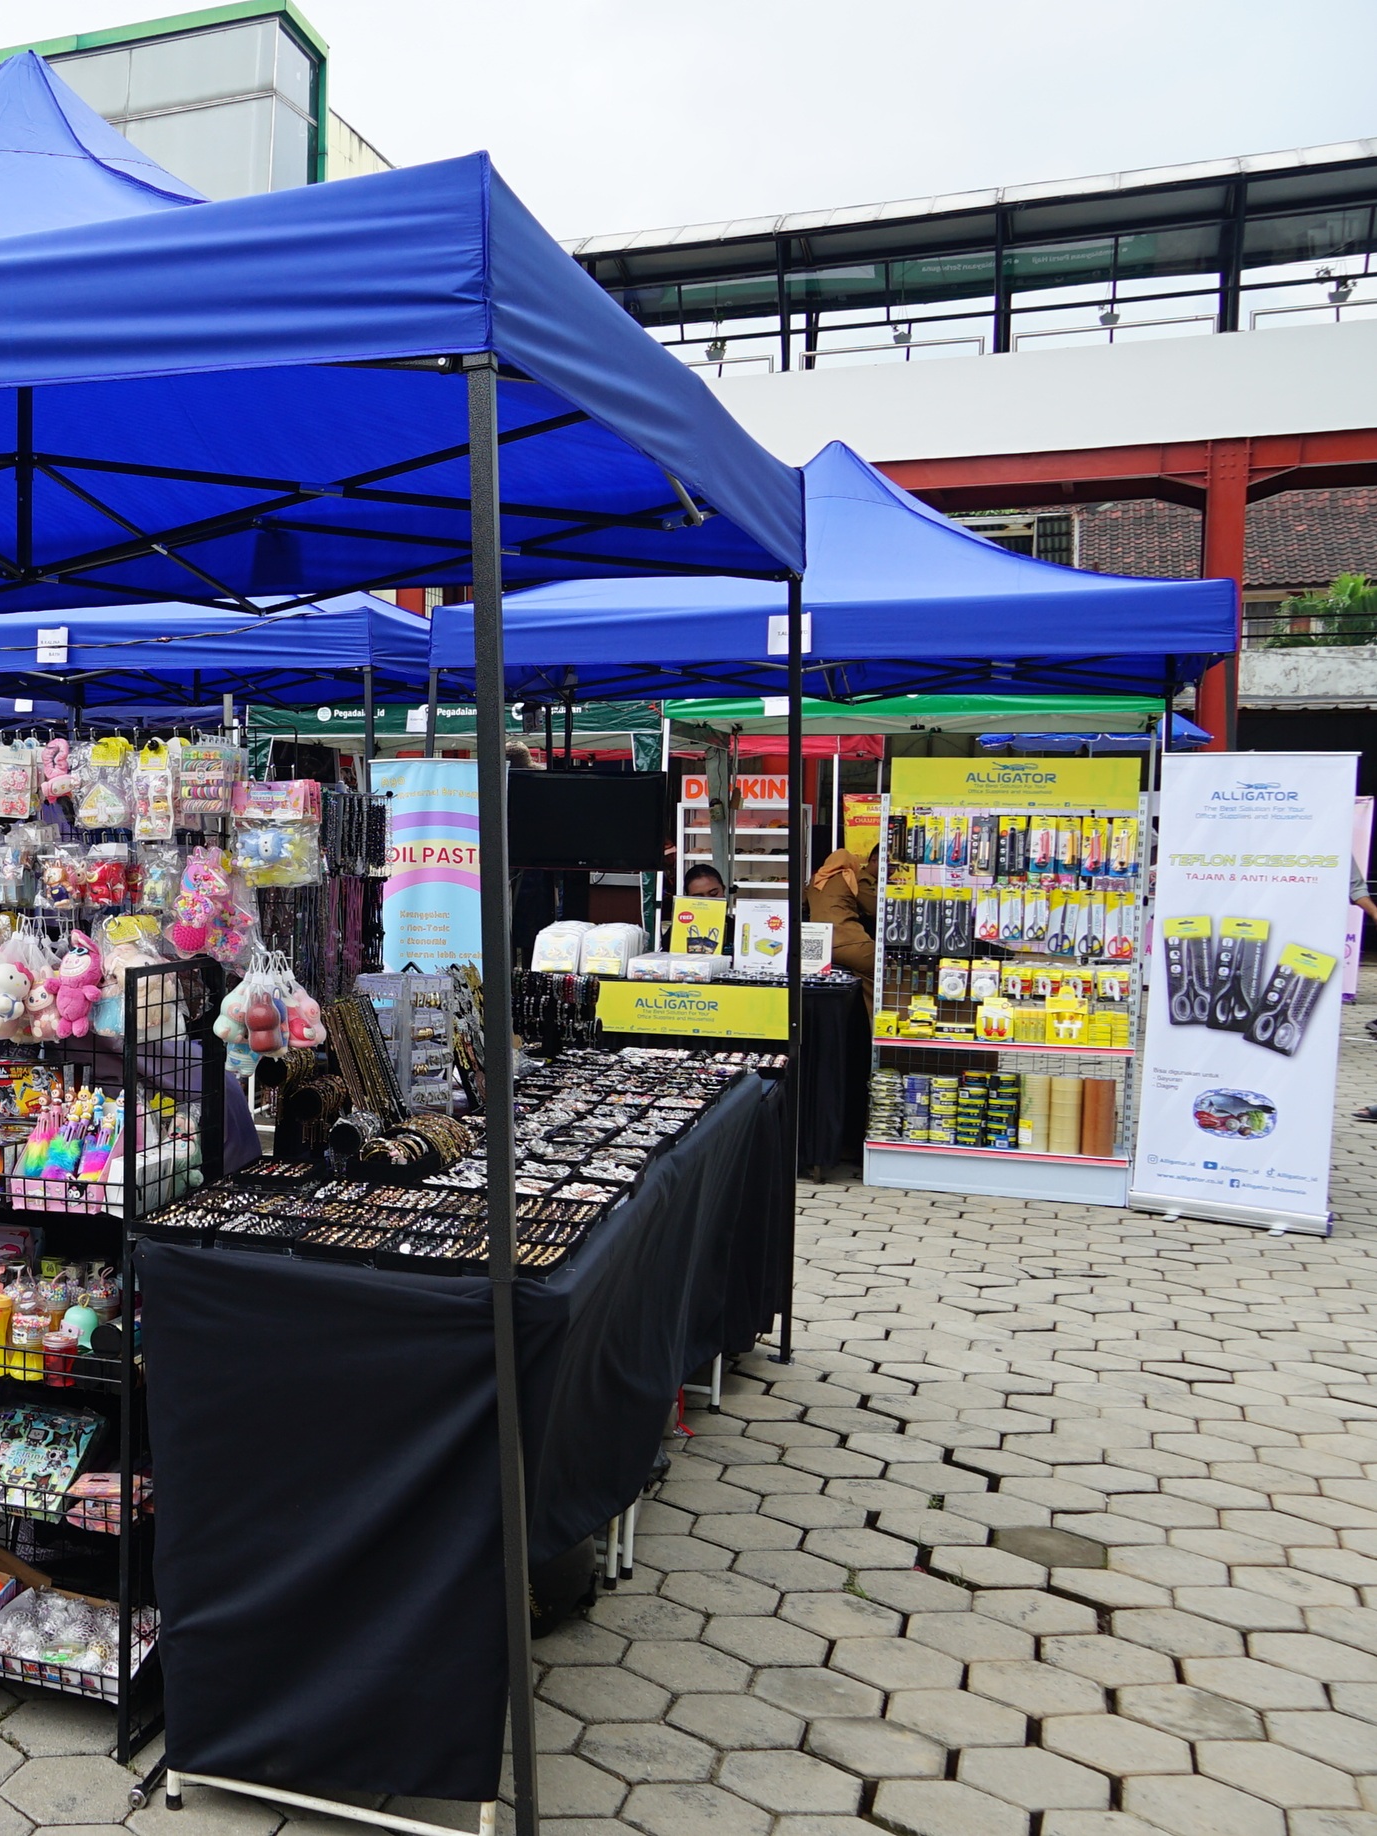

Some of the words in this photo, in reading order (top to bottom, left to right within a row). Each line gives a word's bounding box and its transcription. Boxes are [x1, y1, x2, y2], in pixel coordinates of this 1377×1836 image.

[437, 707, 478, 718] Pegadaian
[966, 773, 1056, 783] ALLIGATOR
[1211, 792, 1298, 801] ALLIGATOR
[1169, 854, 1237, 866] TEFLON
[1240, 854, 1340, 867] SCISSORS
[1186, 873, 1225, 881] TAJAM
[1229, 873, 1236, 881] &
[1241, 874, 1268, 882] ANTI
[635, 998, 718, 1011] ALLIGATOR
